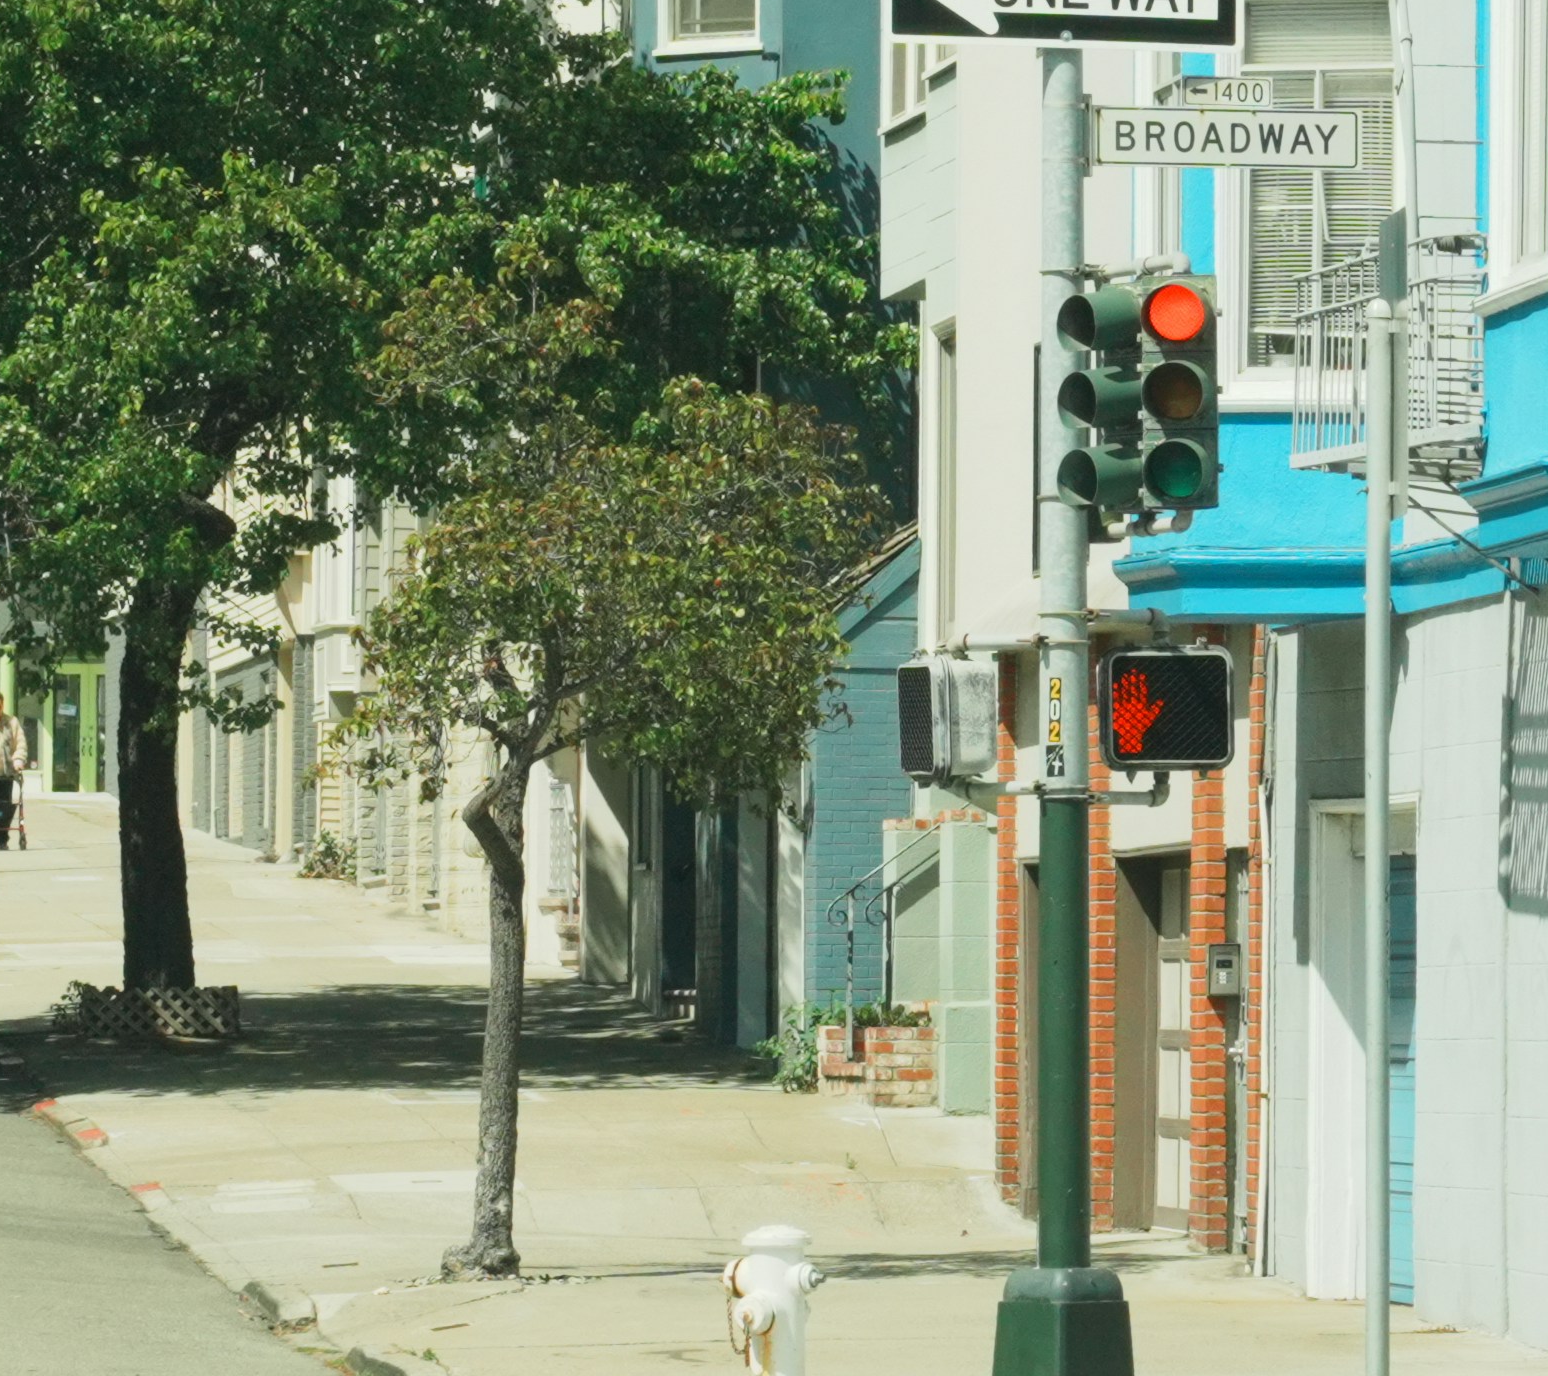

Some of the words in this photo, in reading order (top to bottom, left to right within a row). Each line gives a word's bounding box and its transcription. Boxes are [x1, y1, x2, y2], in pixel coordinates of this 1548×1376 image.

[1212, 81, 1265, 103] 1400
[1114, 120, 1340, 156] BROADWAY
[1049, 678, 1061, 742] 202
